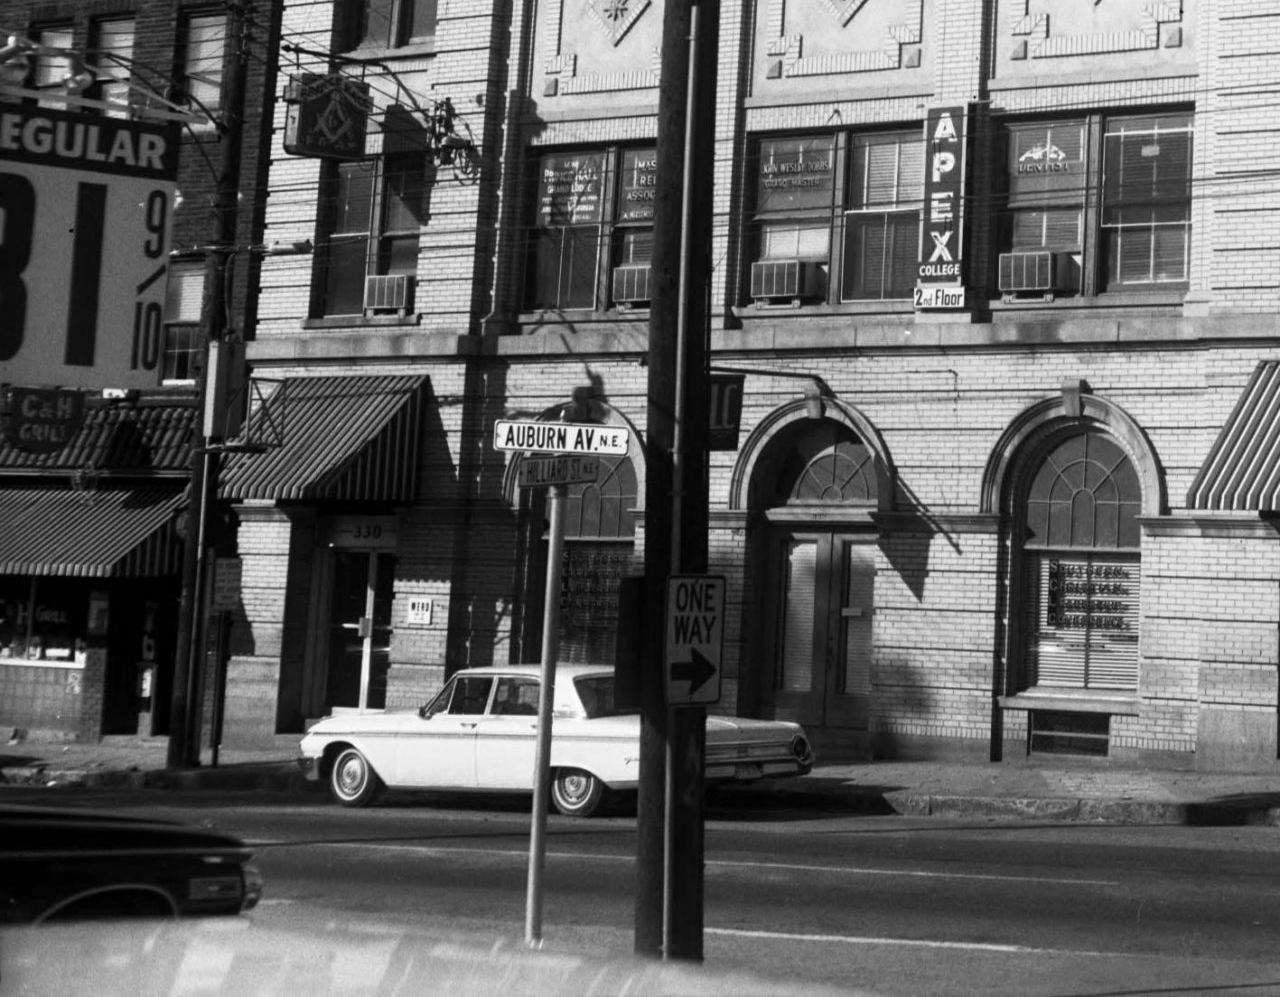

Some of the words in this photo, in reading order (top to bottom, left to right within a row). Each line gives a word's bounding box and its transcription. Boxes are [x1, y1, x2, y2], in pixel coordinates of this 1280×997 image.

[0, 113, 166, 171] EGULAR
[928, 112, 958, 263] APEX
[919, 264, 961, 276] COLLEGE
[915, 288, 933, 307] 2nd
[934, 288, 963, 307] Floor
[505, 425, 567, 450] AUBURN
[574, 428, 599, 451] AV.
[599, 434, 622, 448] N.E.
[526, 458, 568, 483] HILLIARD
[676, 582, 716, 612] ONE
[674, 614, 716, 644] WAY
